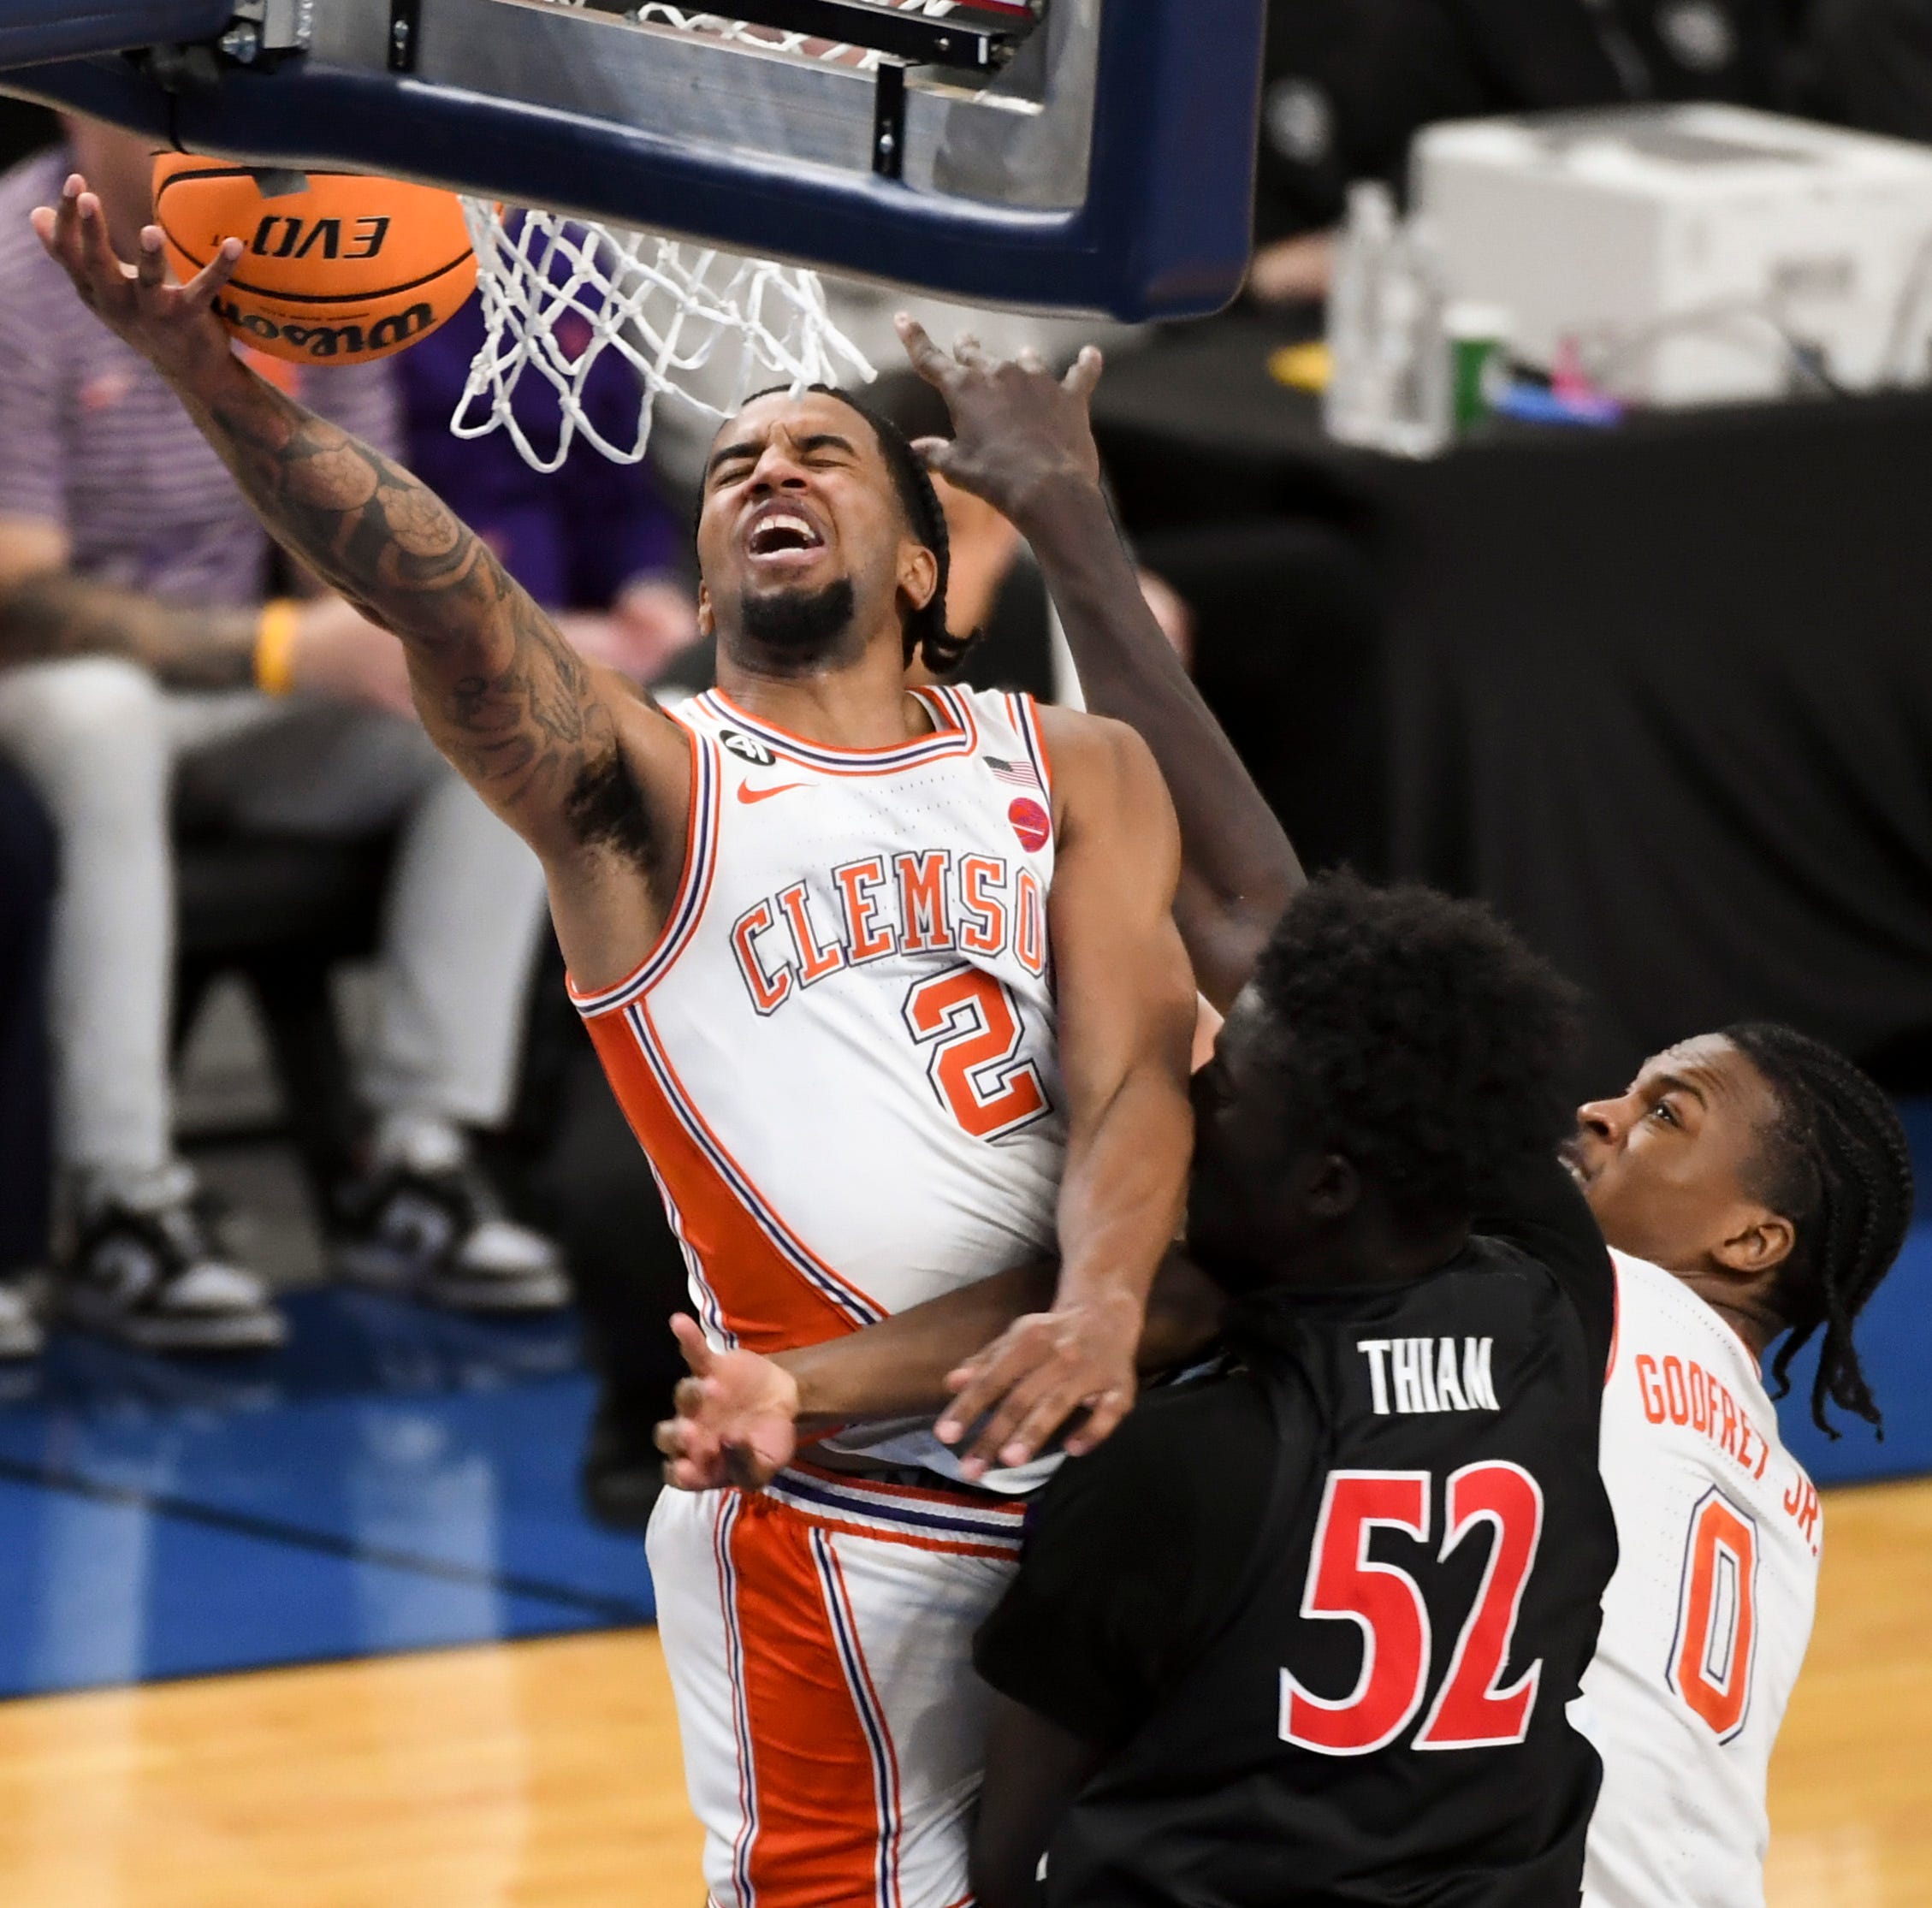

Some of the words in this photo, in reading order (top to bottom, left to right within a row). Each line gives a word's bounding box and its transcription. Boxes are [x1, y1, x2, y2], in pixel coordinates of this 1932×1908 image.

[252, 216, 391, 259] EVO
[210, 296, 438, 358] Wilson
[726, 735, 769, 763] 41
[729, 849, 1046, 1017] CLEMSO
[901, 962, 1054, 1143] 2
[1635, 1354, 1769, 1481] GODFREY
[1784, 1473, 1819, 1557] JR.
[1279, 1460, 1544, 1756] 52
[1666, 1484, 1760, 1745] 0
